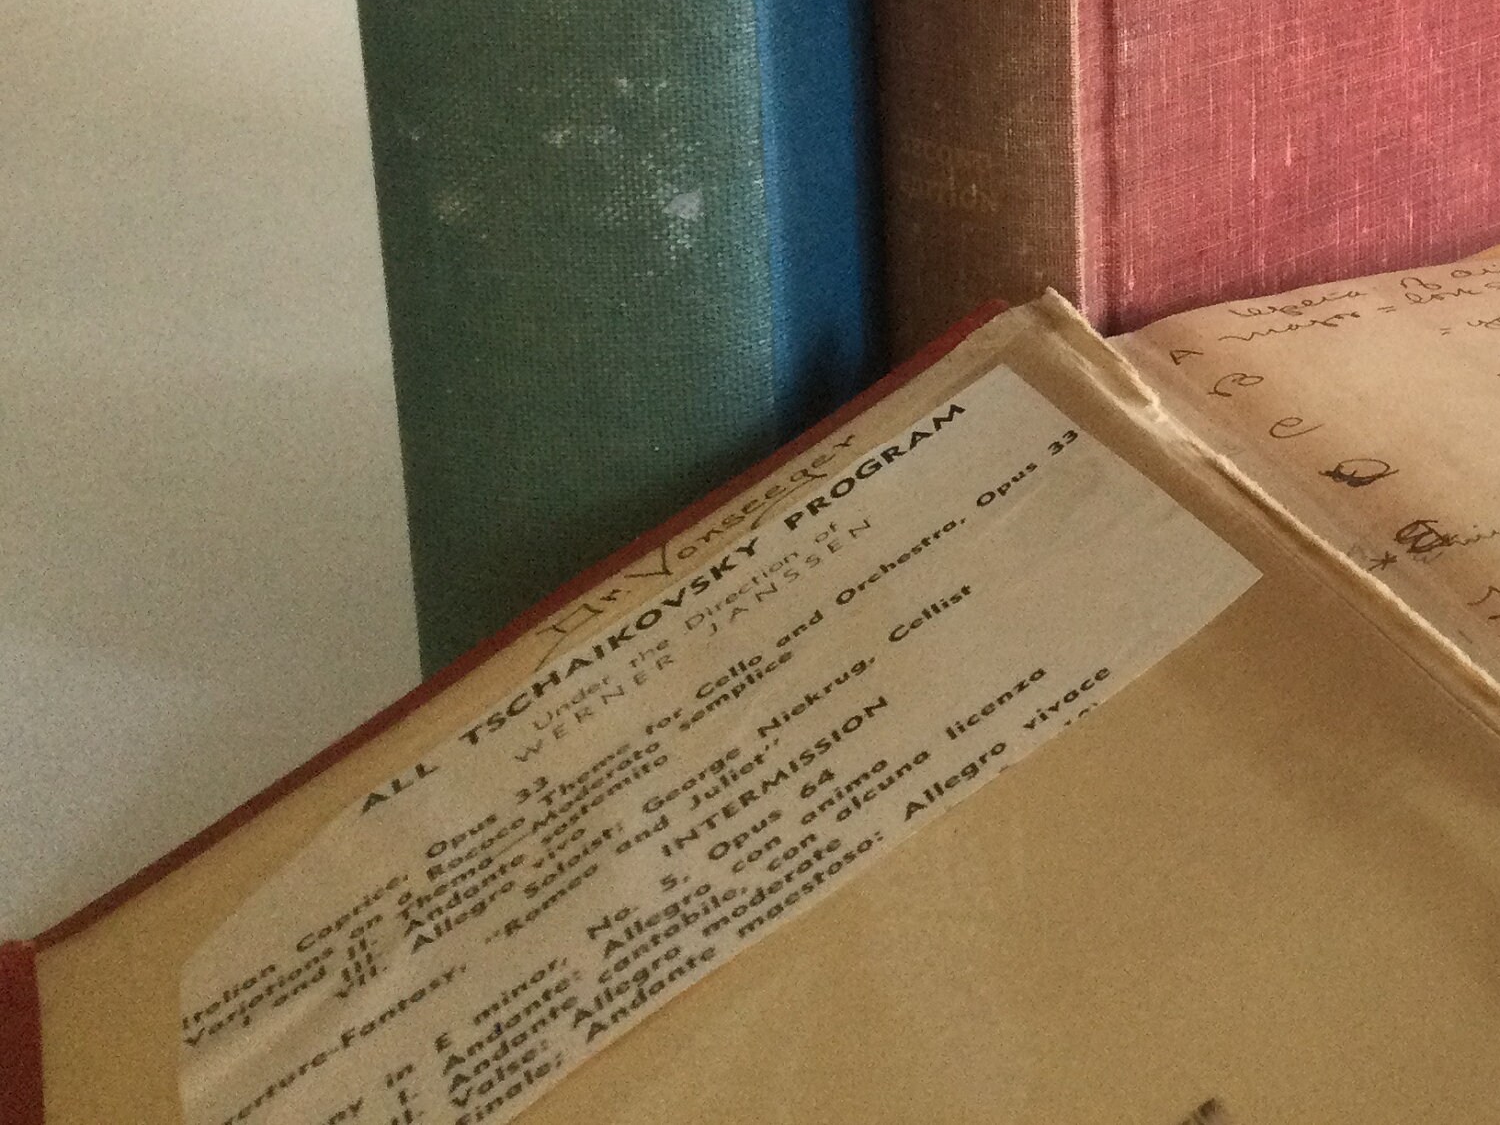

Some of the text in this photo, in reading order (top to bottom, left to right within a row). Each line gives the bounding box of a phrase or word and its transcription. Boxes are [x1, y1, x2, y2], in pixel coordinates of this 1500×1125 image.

[1168, 348, 1204, 366] A
[361, 404, 966, 815] ALL TSCHAIKOVSKY PROGRAM
[513, 518, 872, 763] WERNER JANSSEN
[539, 743, 630, 807] Theme
[644, 707, 683, 736] for
[695, 654, 763, 700] Cello
[775, 609, 824, 648] and
[835, 518, 966, 606] Orchestra,
[975, 462, 1038, 508] Opus
[1047, 429, 1079, 456] 33
[628, 638, 670, 669] the
[684, 550, 800, 631] Direction
[813, 521, 837, 544] of
[641, 747, 741, 814] George
[756, 656, 876, 739] Niekrug,
[888, 585, 972, 643] Cellist
[678, 650, 793, 732] semplice
[586, 946, 716, 1044] Andante
[904, 742, 1007, 822] Allegro
[1022, 667, 1111, 731] vivace
[615, 814, 670, 855] and
[661, 695, 889, 858] INTERMISSION
[182, 963, 277, 1031] Italian
[424, 813, 498, 870] Opus
[403, 854, 525, 939] Andante
[411, 870, 516, 954] Allegro
[434, 1031, 452, 1054] E
[472, 957, 568, 1026] minor,
[707, 810, 783, 861] Opus
[799, 768, 836, 800] 64
[448, 996, 578, 1096] Andante
[766, 833, 818, 872] con
[945, 667, 1047, 741] licenza
[603, 883, 712, 960] Allegro
[731, 835, 782, 874] con
[571, 946, 681, 1030] Allegro
